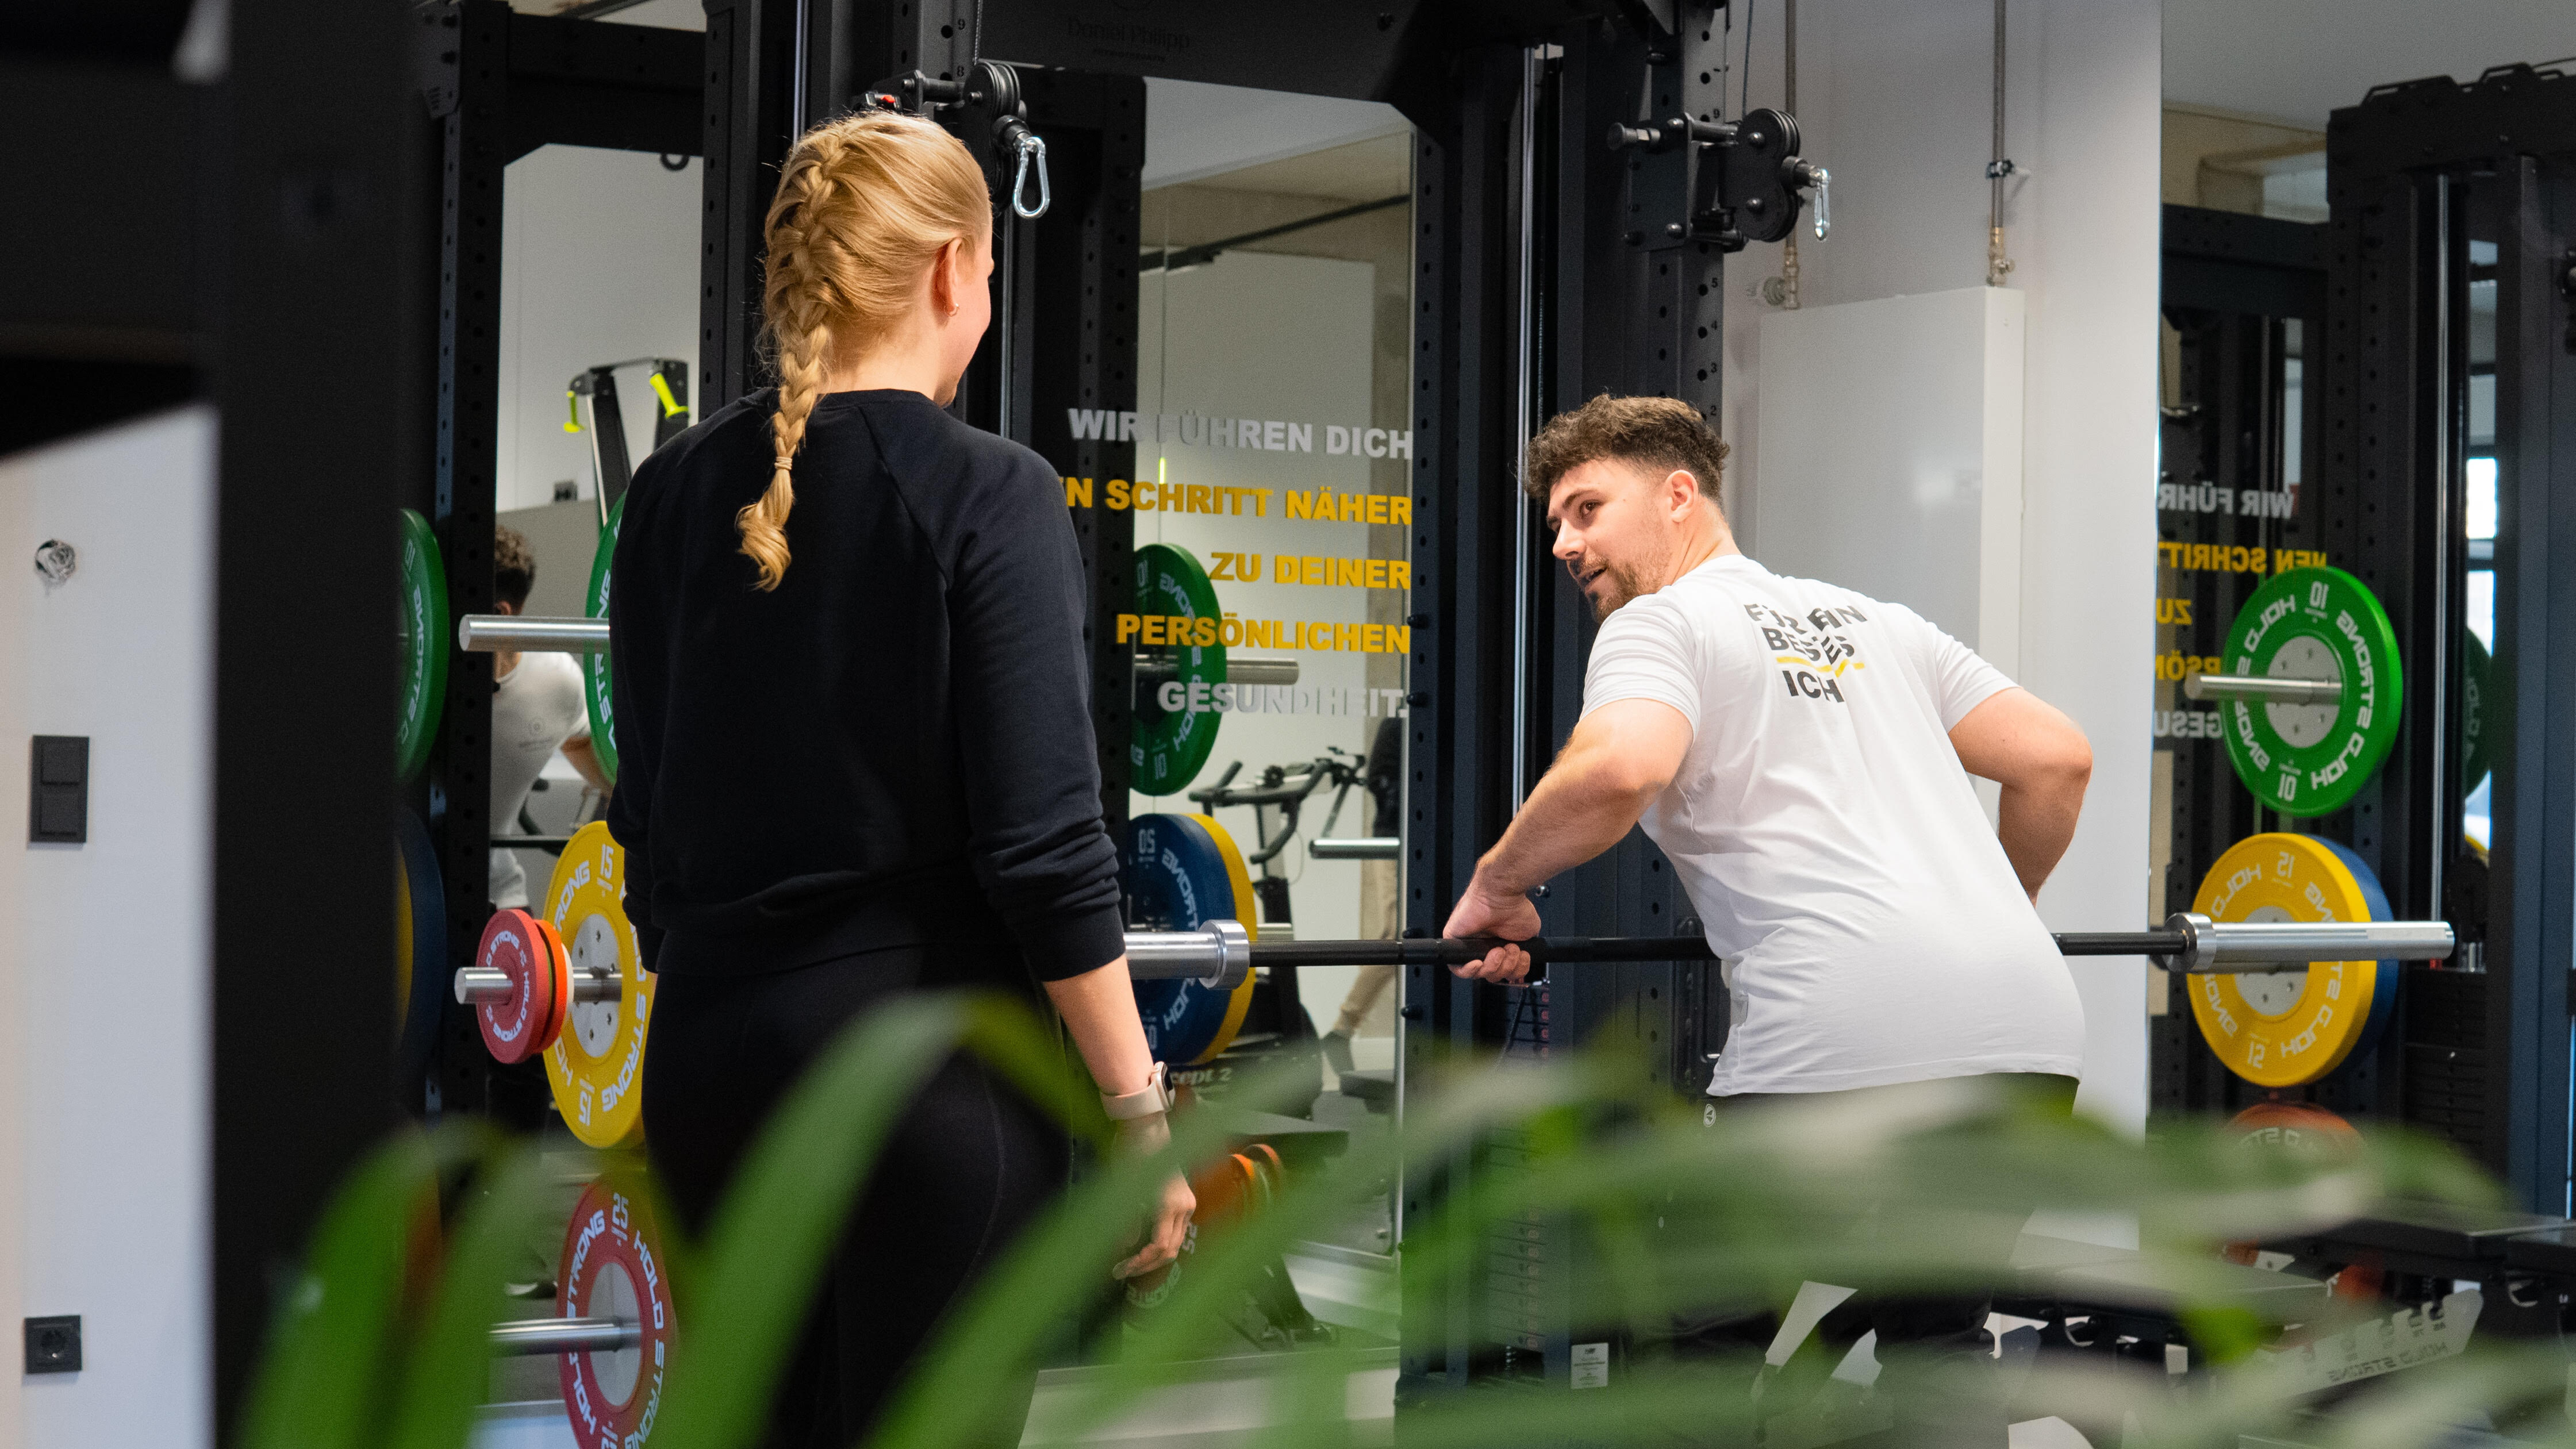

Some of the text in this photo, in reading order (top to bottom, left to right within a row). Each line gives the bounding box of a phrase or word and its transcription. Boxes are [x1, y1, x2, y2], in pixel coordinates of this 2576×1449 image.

[1711, 277, 1718, 288] 5
[1710, 363, 1718, 374] 3
[1068, 408, 1412, 459] WIR FÜHREN DICH
[1105, 479, 1273, 517] SCHRITT
[1285, 486, 1412, 525] NÄHER
[1209, 552, 1411, 590] ZU DEINER
[1116, 612, 1410, 654] PERSÖNLICHEN
[1782, 670, 1845, 702] ICH
[600, 843, 614, 879] 15
[601, 991, 646, 1113] STRONG
[611, 1192, 629, 1231] 25
[634, 1229, 664, 1330] HOLD
